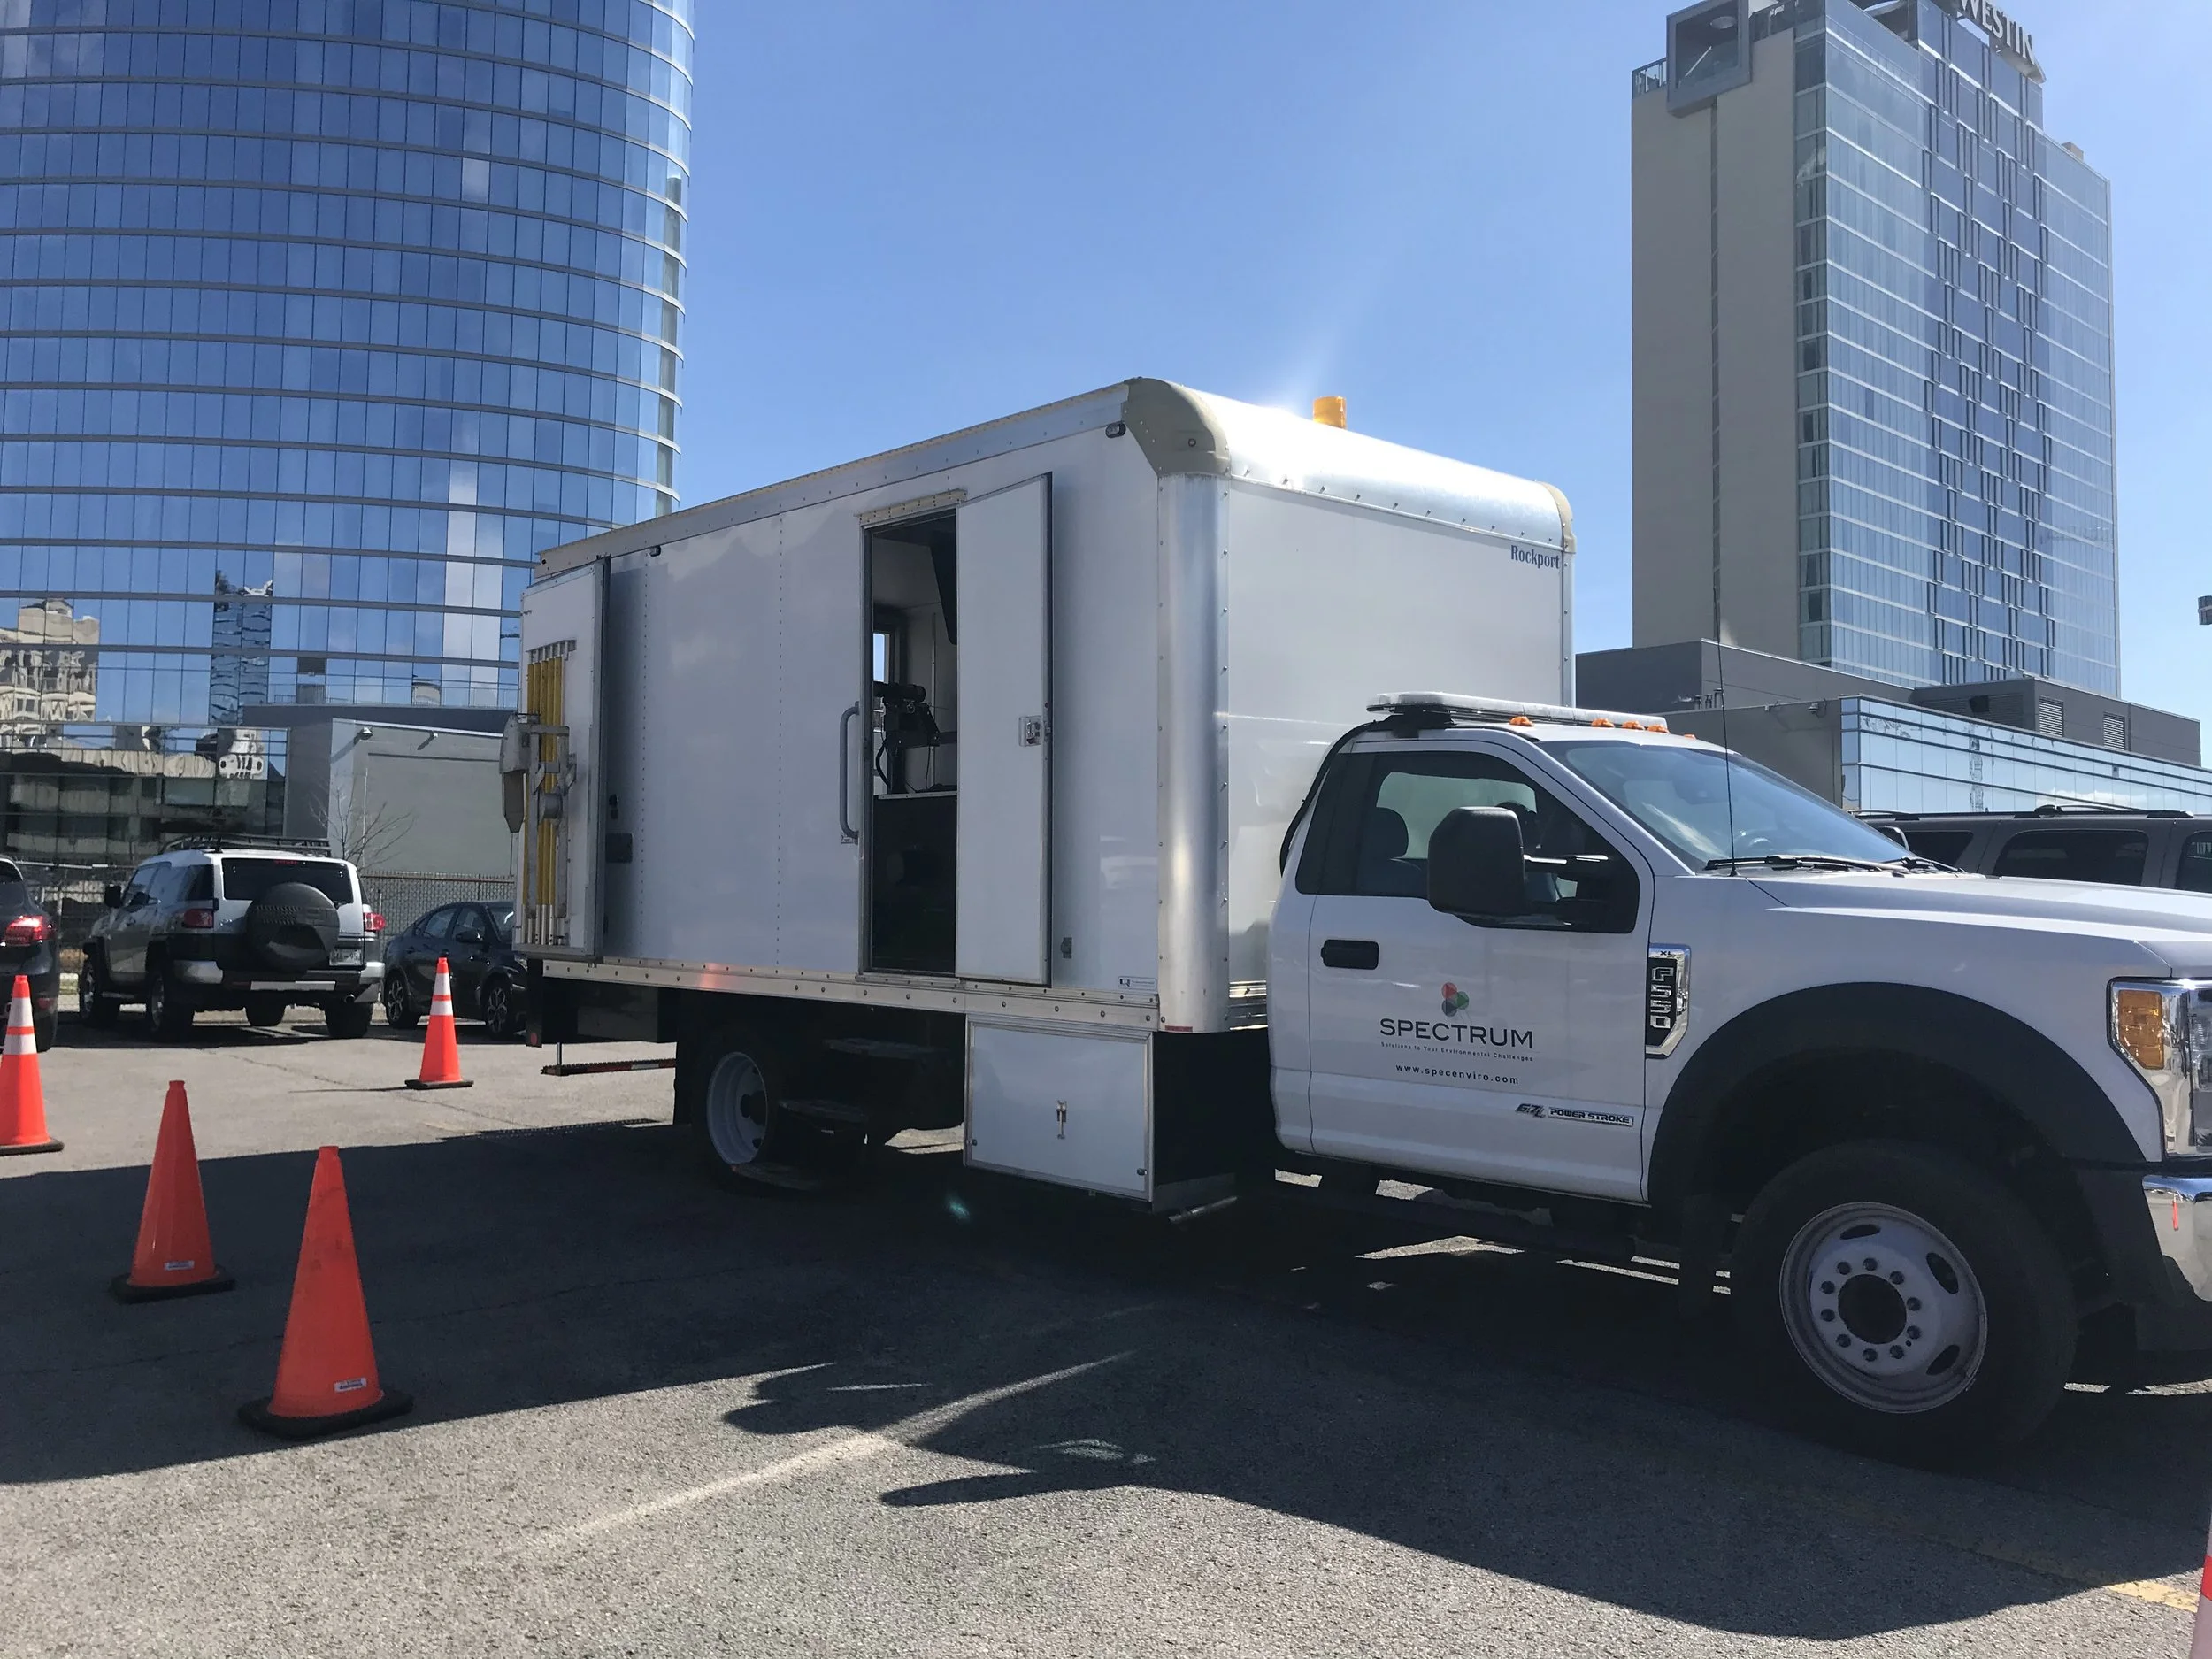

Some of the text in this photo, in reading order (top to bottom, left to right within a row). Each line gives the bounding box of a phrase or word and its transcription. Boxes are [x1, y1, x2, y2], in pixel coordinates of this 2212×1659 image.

[1510, 545, 1560, 569] Rockport
[1379, 1018, 1532, 1048] SPECTRUM
[1440, 1048, 1490, 1057] Environmental
[1493, 1052, 1533, 1062] Challenges
[1395, 1064, 1519, 1084] www.specenviro.com
[1550, 1108, 1586, 1118] POWER
[1587, 1112, 1630, 1124] STROKE
